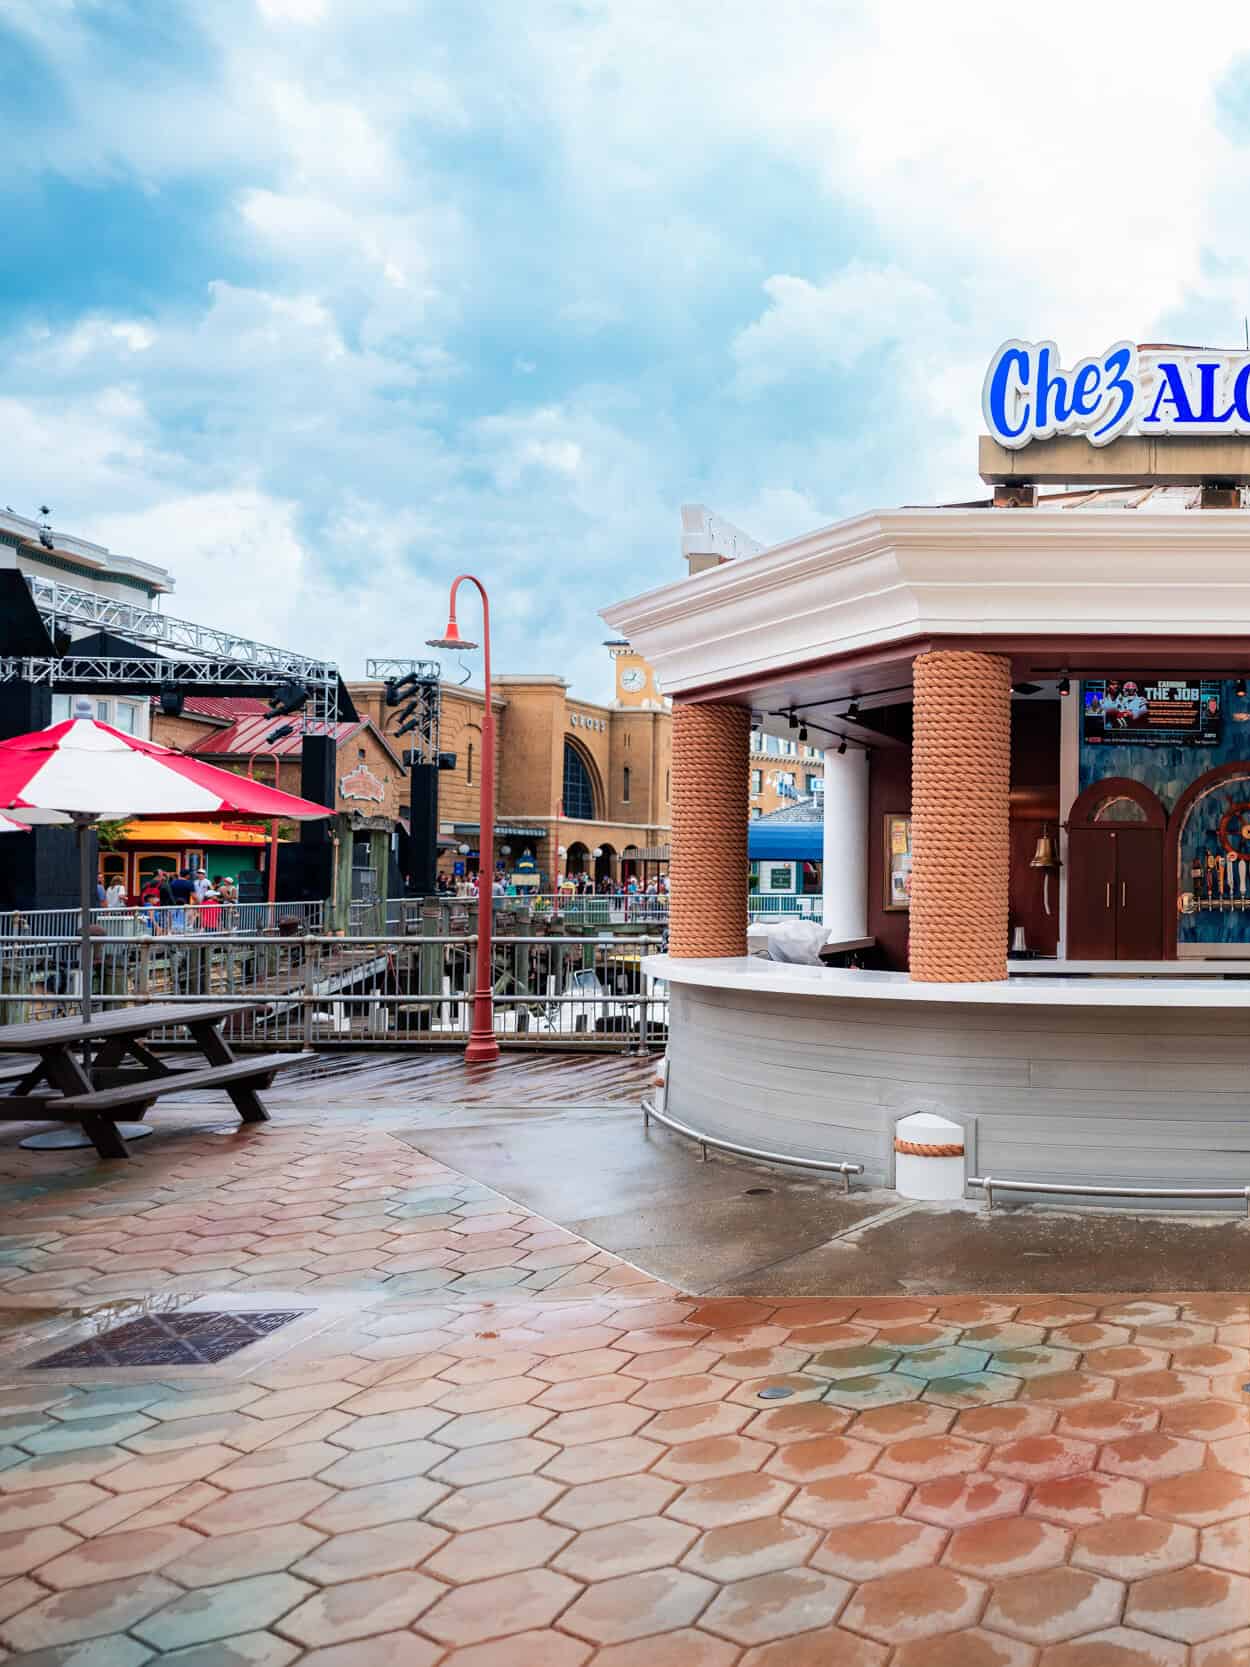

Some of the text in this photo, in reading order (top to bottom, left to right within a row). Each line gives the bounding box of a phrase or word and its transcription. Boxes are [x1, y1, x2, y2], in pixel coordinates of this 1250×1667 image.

[990, 348, 1134, 437] Chez
[1144, 687, 1199, 701] THE JOB
